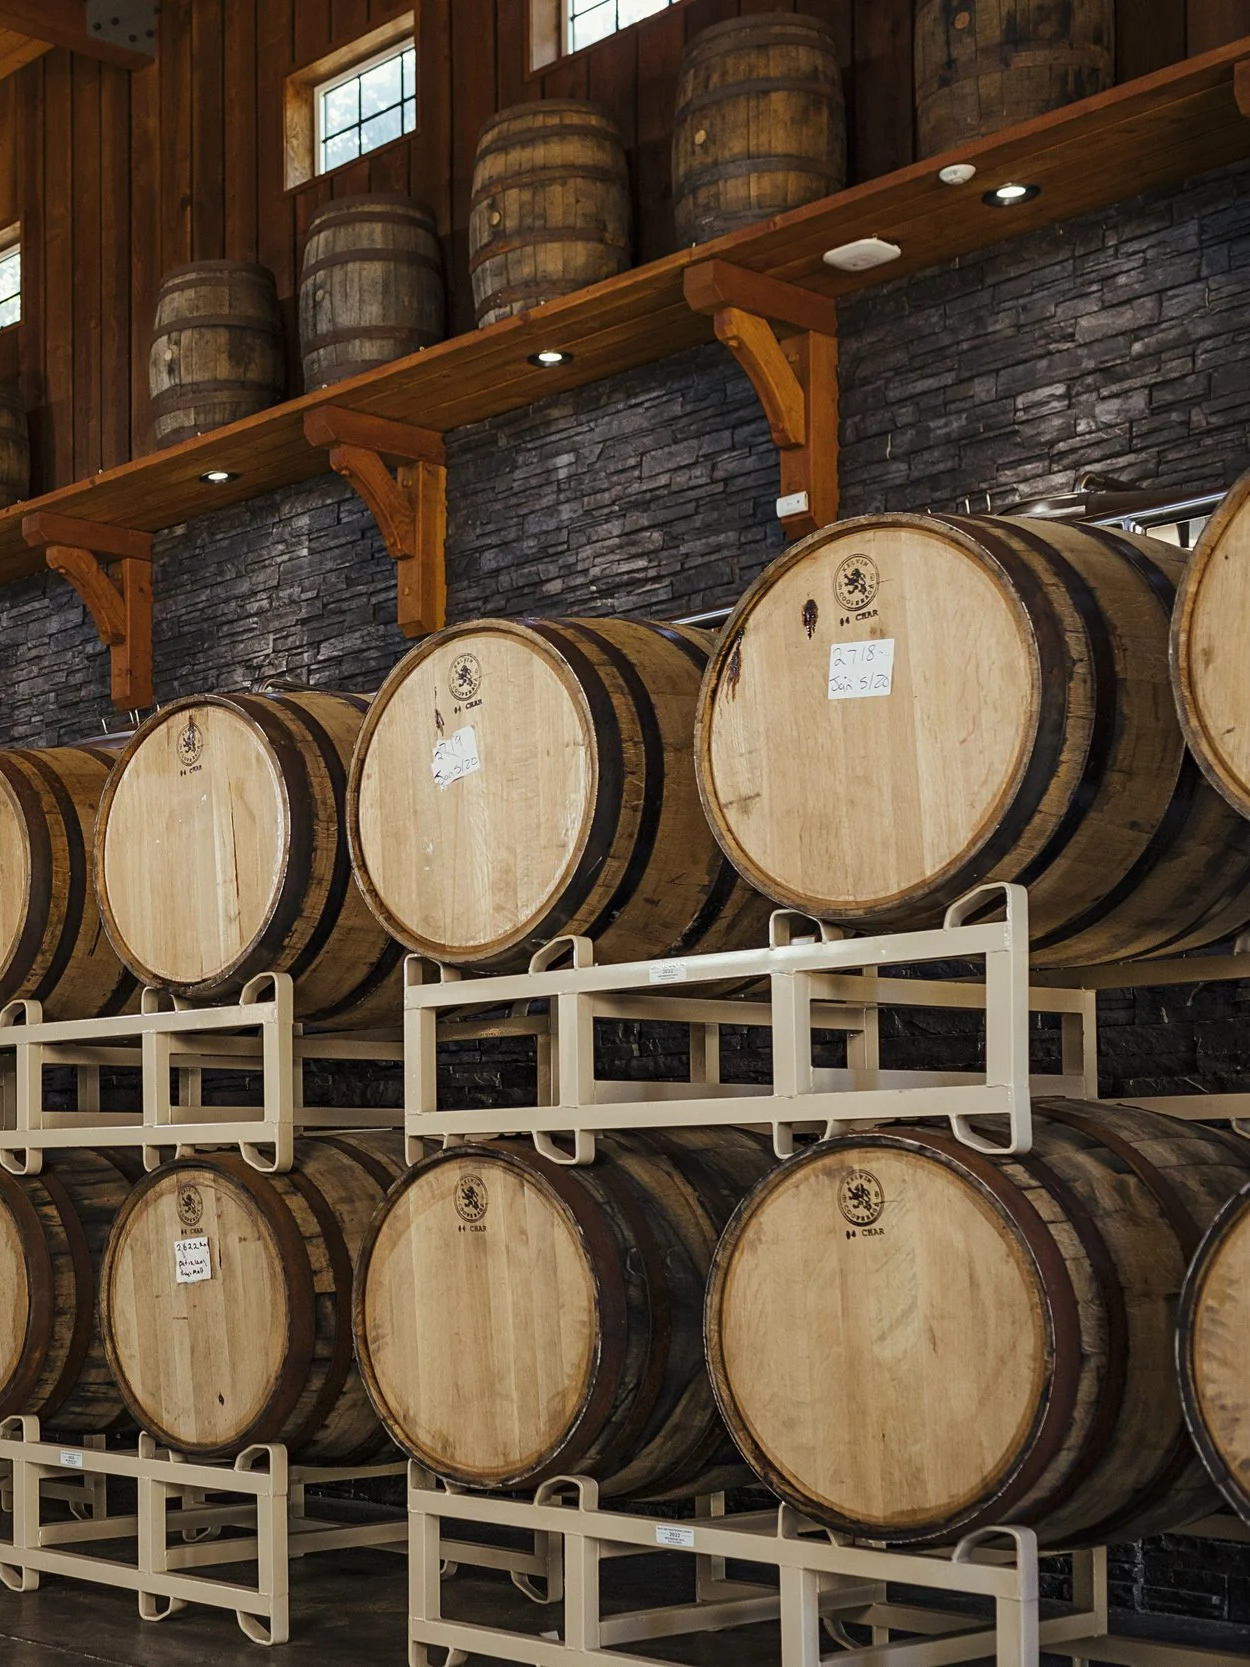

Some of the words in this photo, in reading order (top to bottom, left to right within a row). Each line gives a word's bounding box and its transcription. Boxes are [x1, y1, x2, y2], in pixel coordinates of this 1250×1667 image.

[842, 558, 869, 573] KELVIN
[855, 609, 879, 622] CHAR
[861, 1228, 885, 1237] CHAR
